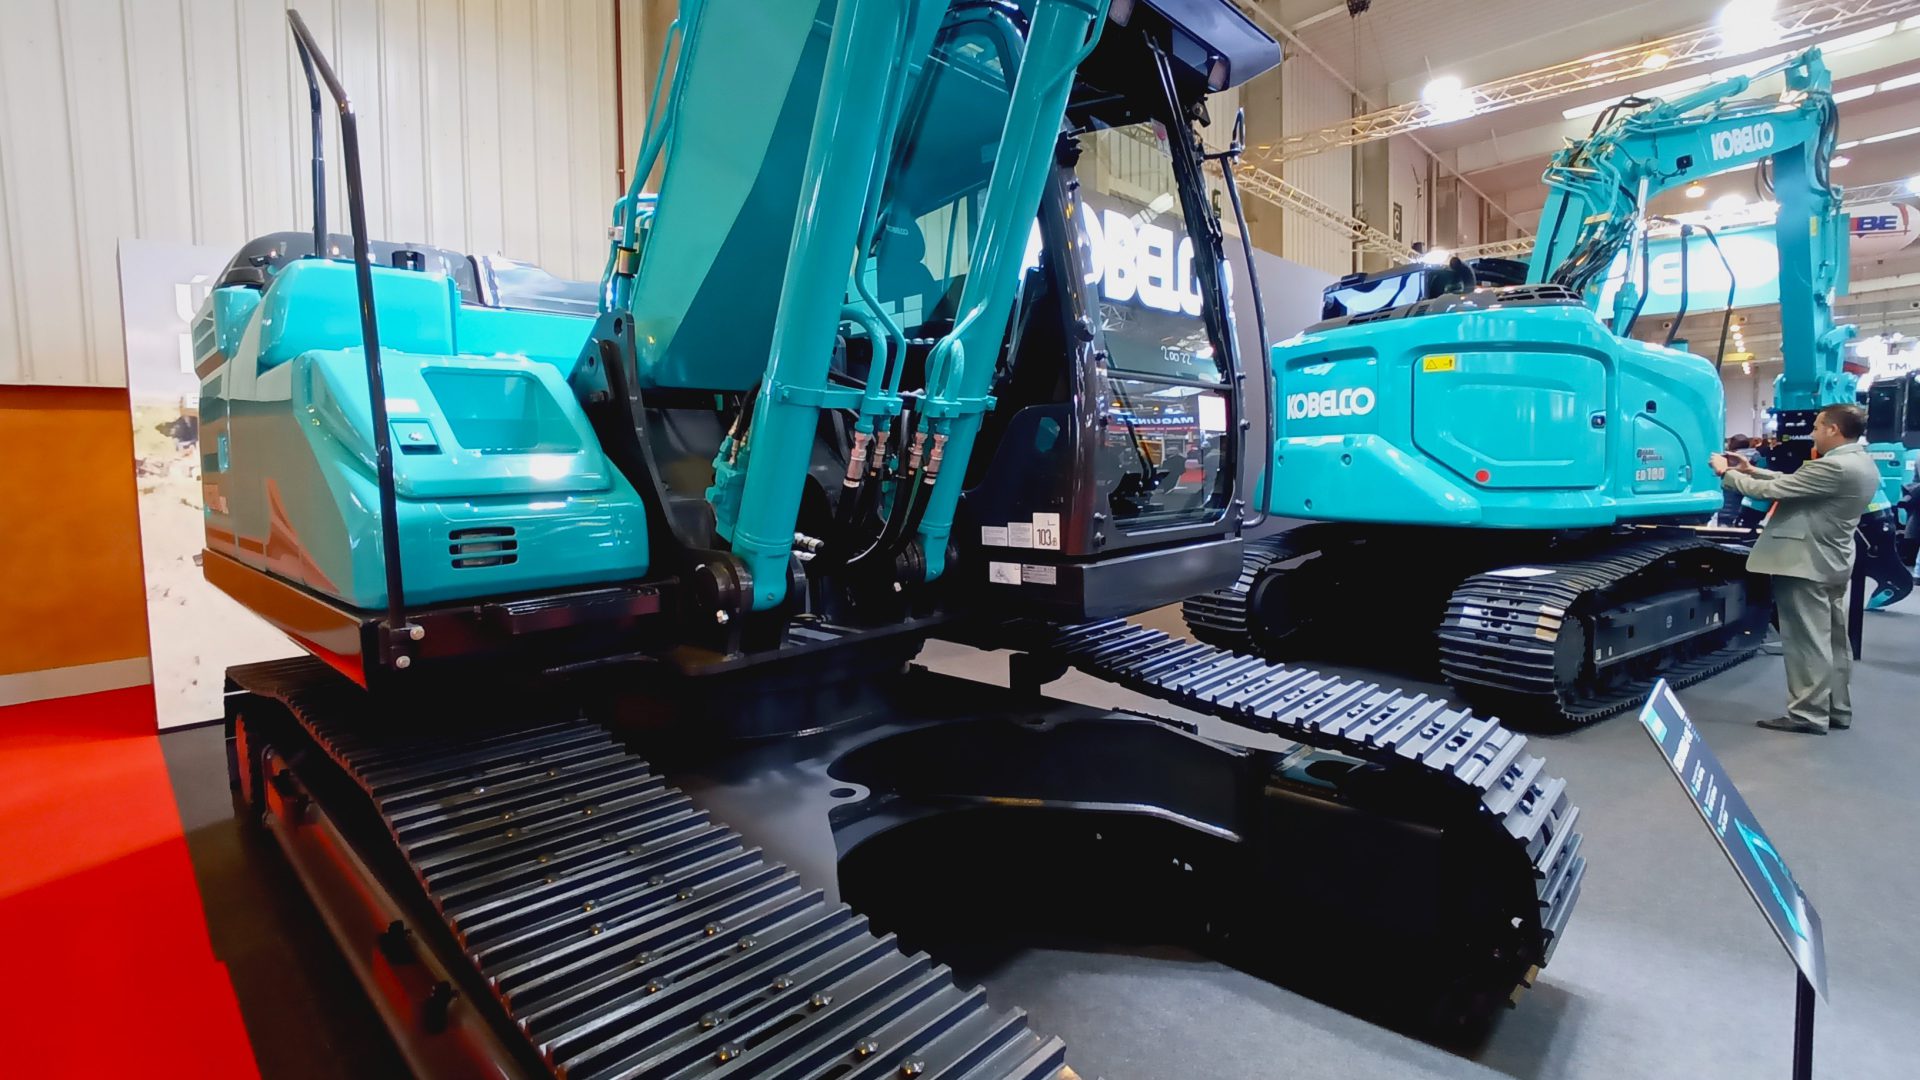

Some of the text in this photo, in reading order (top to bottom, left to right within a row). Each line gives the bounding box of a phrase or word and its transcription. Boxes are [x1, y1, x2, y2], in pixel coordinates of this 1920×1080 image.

[1710, 121, 1774, 160] KOBELCO
[1286, 386, 1375, 420] KOBELCO
[1036, 528, 1052, 547] 103
